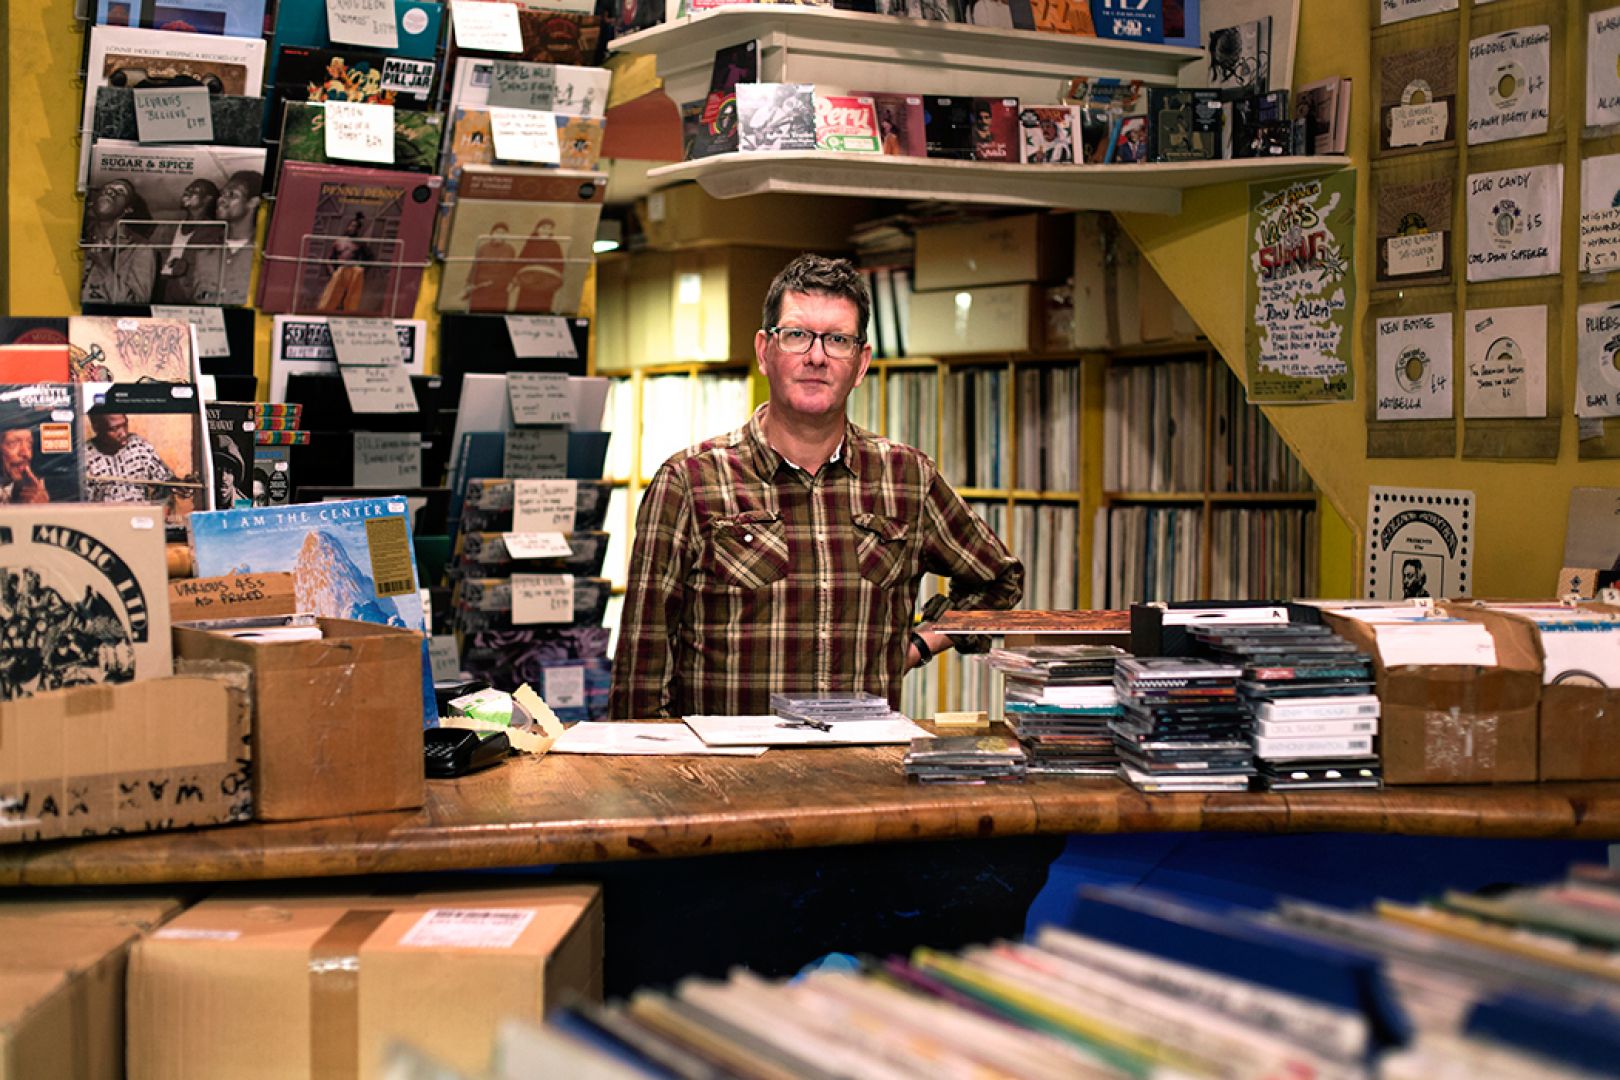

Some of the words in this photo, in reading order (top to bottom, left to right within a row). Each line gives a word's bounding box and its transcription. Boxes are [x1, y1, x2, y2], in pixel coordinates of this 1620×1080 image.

[383, 71, 407, 86] PILL
[407, 74, 430, 87] JAR
[101, 158, 142, 168] SUGAR
[146, 160, 155, 168] &
[158, 161, 194, 170] SPICE
[1498, 172, 1531, 189] CANDY
[1527, 213, 1542, 231] £5
[1264, 303, 1290, 321] Tony
[1295, 301, 1329, 320] Allen
[1380, 322, 1399, 336] KEN
[222, 519, 227, 529] I
[240, 516, 266, 528] AM
[277, 512, 310, 524] THE
[319, 505, 383, 521] CENTER
[36, 526, 116, 571] MUSIC
[174, 582, 229, 597] VARIOUS
[195, 596, 213, 607] AS
